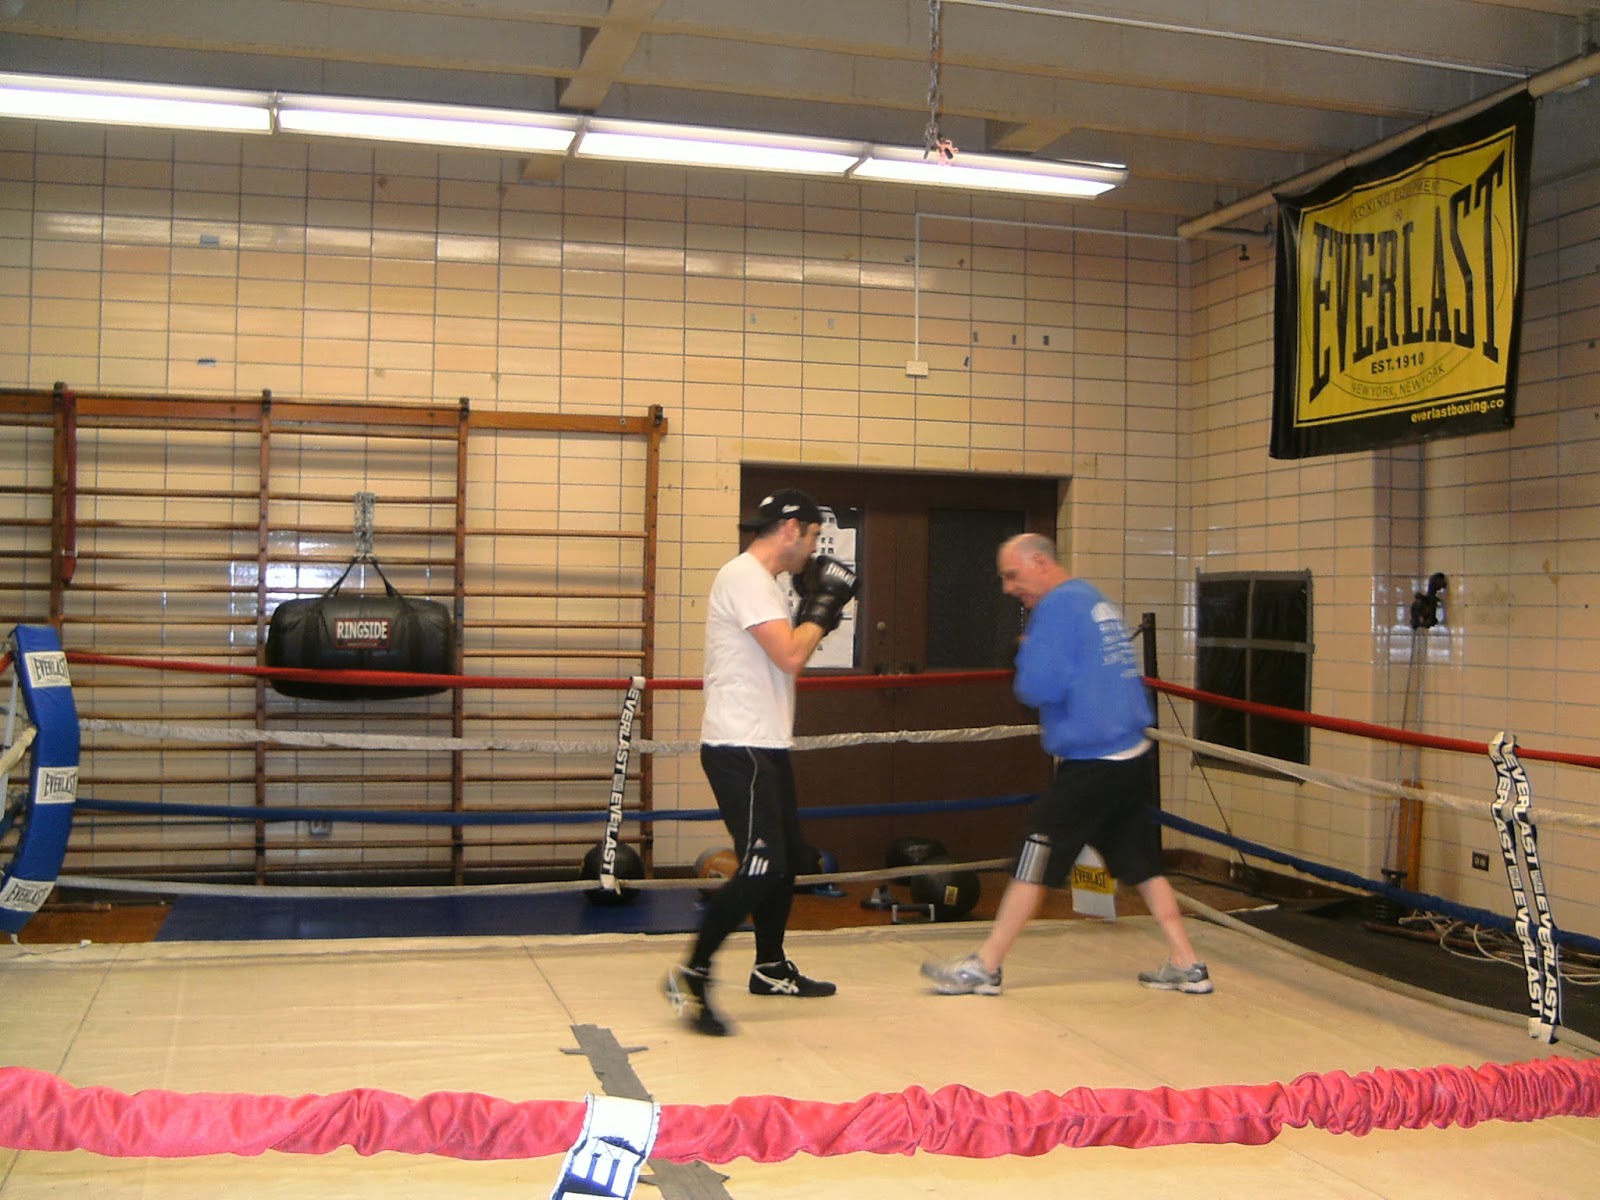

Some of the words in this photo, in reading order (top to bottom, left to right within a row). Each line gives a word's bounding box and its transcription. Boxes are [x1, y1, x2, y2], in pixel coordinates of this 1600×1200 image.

[1309, 150, 1505, 404] EVERLAST
[1351, 382, 1369, 395] NEW
[1400, 379, 1420, 394] NEW
[1420, 365, 1445, 386] YORK
[337, 621, 388, 639] RINGSIDE
[33, 656, 69, 680] EVERLAST
[615, 687, 640, 775] EVERLAST
[44, 772, 77, 797] EVERLAST
[1513, 890, 1543, 1017] EVERLAST
[1536, 894, 1558, 1025] EVERLAST
